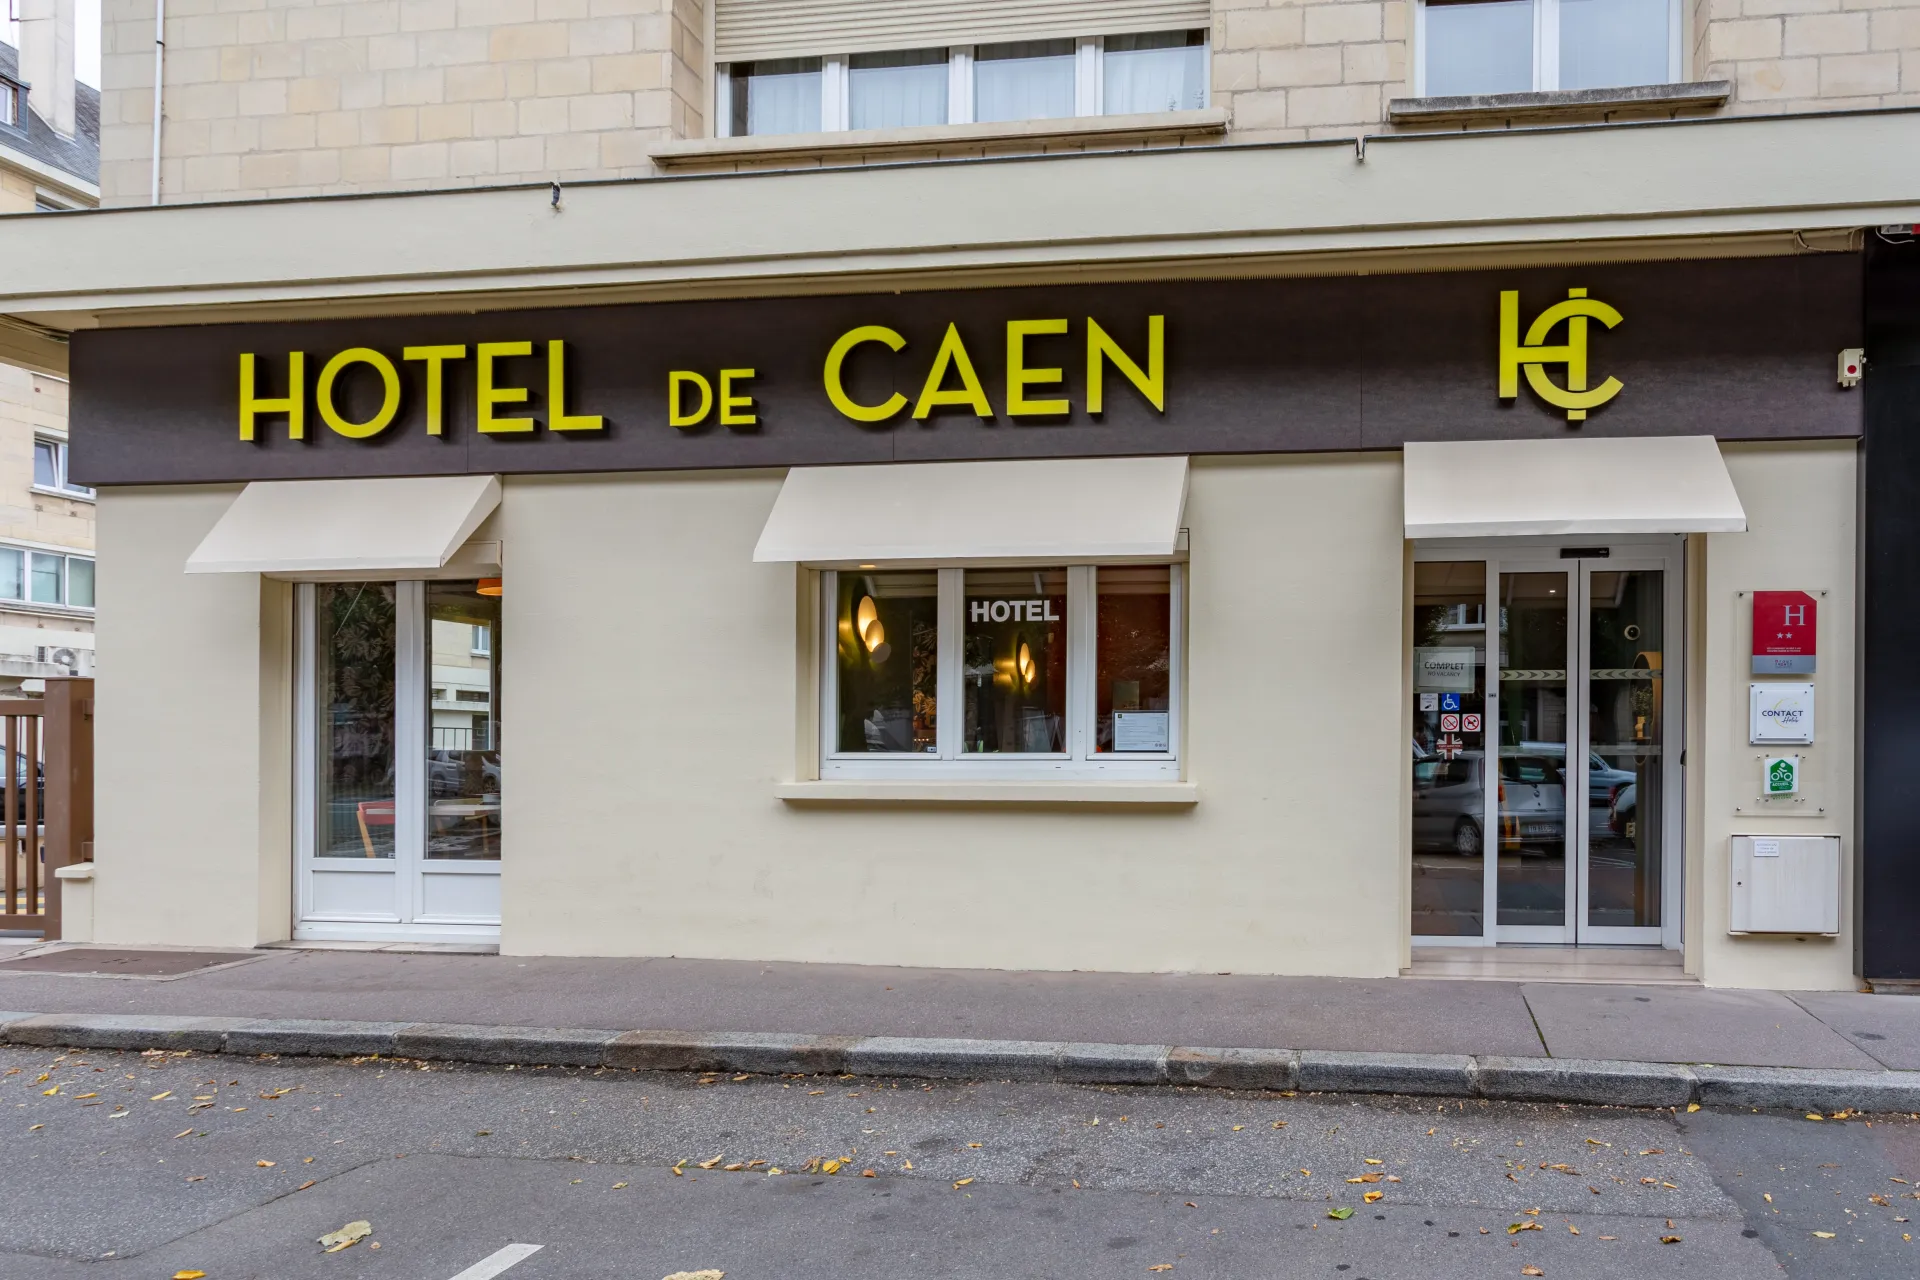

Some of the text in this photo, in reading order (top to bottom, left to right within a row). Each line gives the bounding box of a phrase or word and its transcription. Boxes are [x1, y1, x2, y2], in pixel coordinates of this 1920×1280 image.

[239, 315, 1165, 441] HOTEL DE CAEN
[971, 600, 1059, 622] HOTEL
[1783, 605, 1806, 626] H
[1424, 661, 1465, 670] COMPLET
